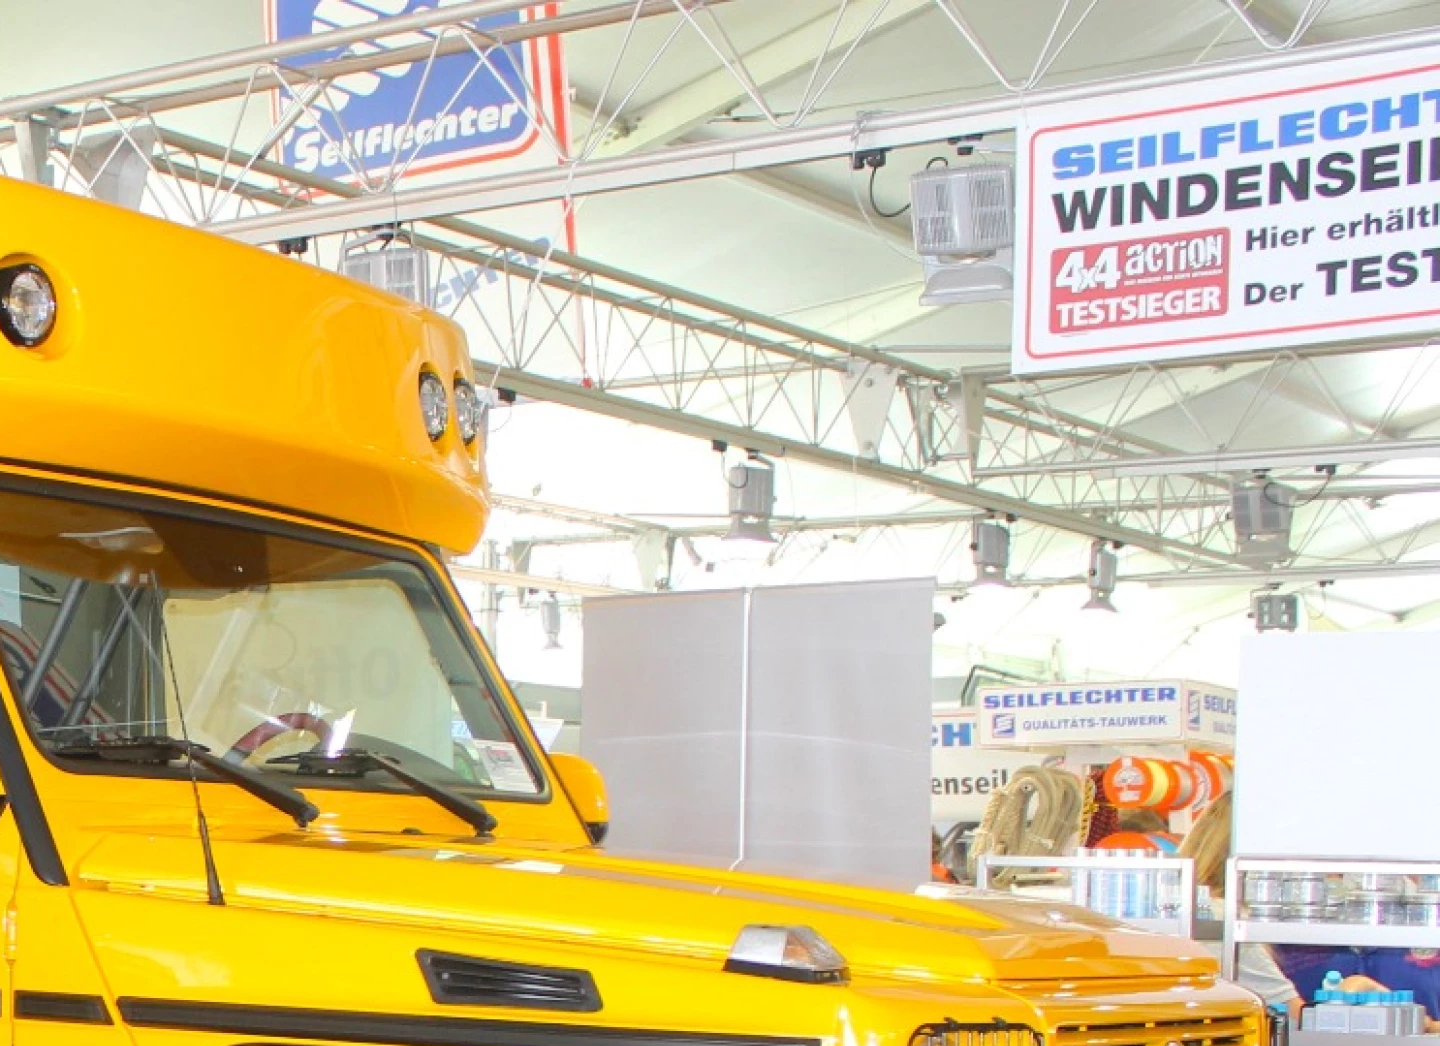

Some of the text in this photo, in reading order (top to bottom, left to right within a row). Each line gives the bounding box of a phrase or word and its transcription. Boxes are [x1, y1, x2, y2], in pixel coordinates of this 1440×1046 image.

[294, 102, 519, 172] Seilflechter
[1245, 225, 1316, 252] Hier
[1055, 245, 1122, 294] 4x4
[1055, 286, 1222, 329] TESTSIEGER
[1244, 282, 1305, 307] Der
[983, 687, 1177, 710] SEILFLECHTER
